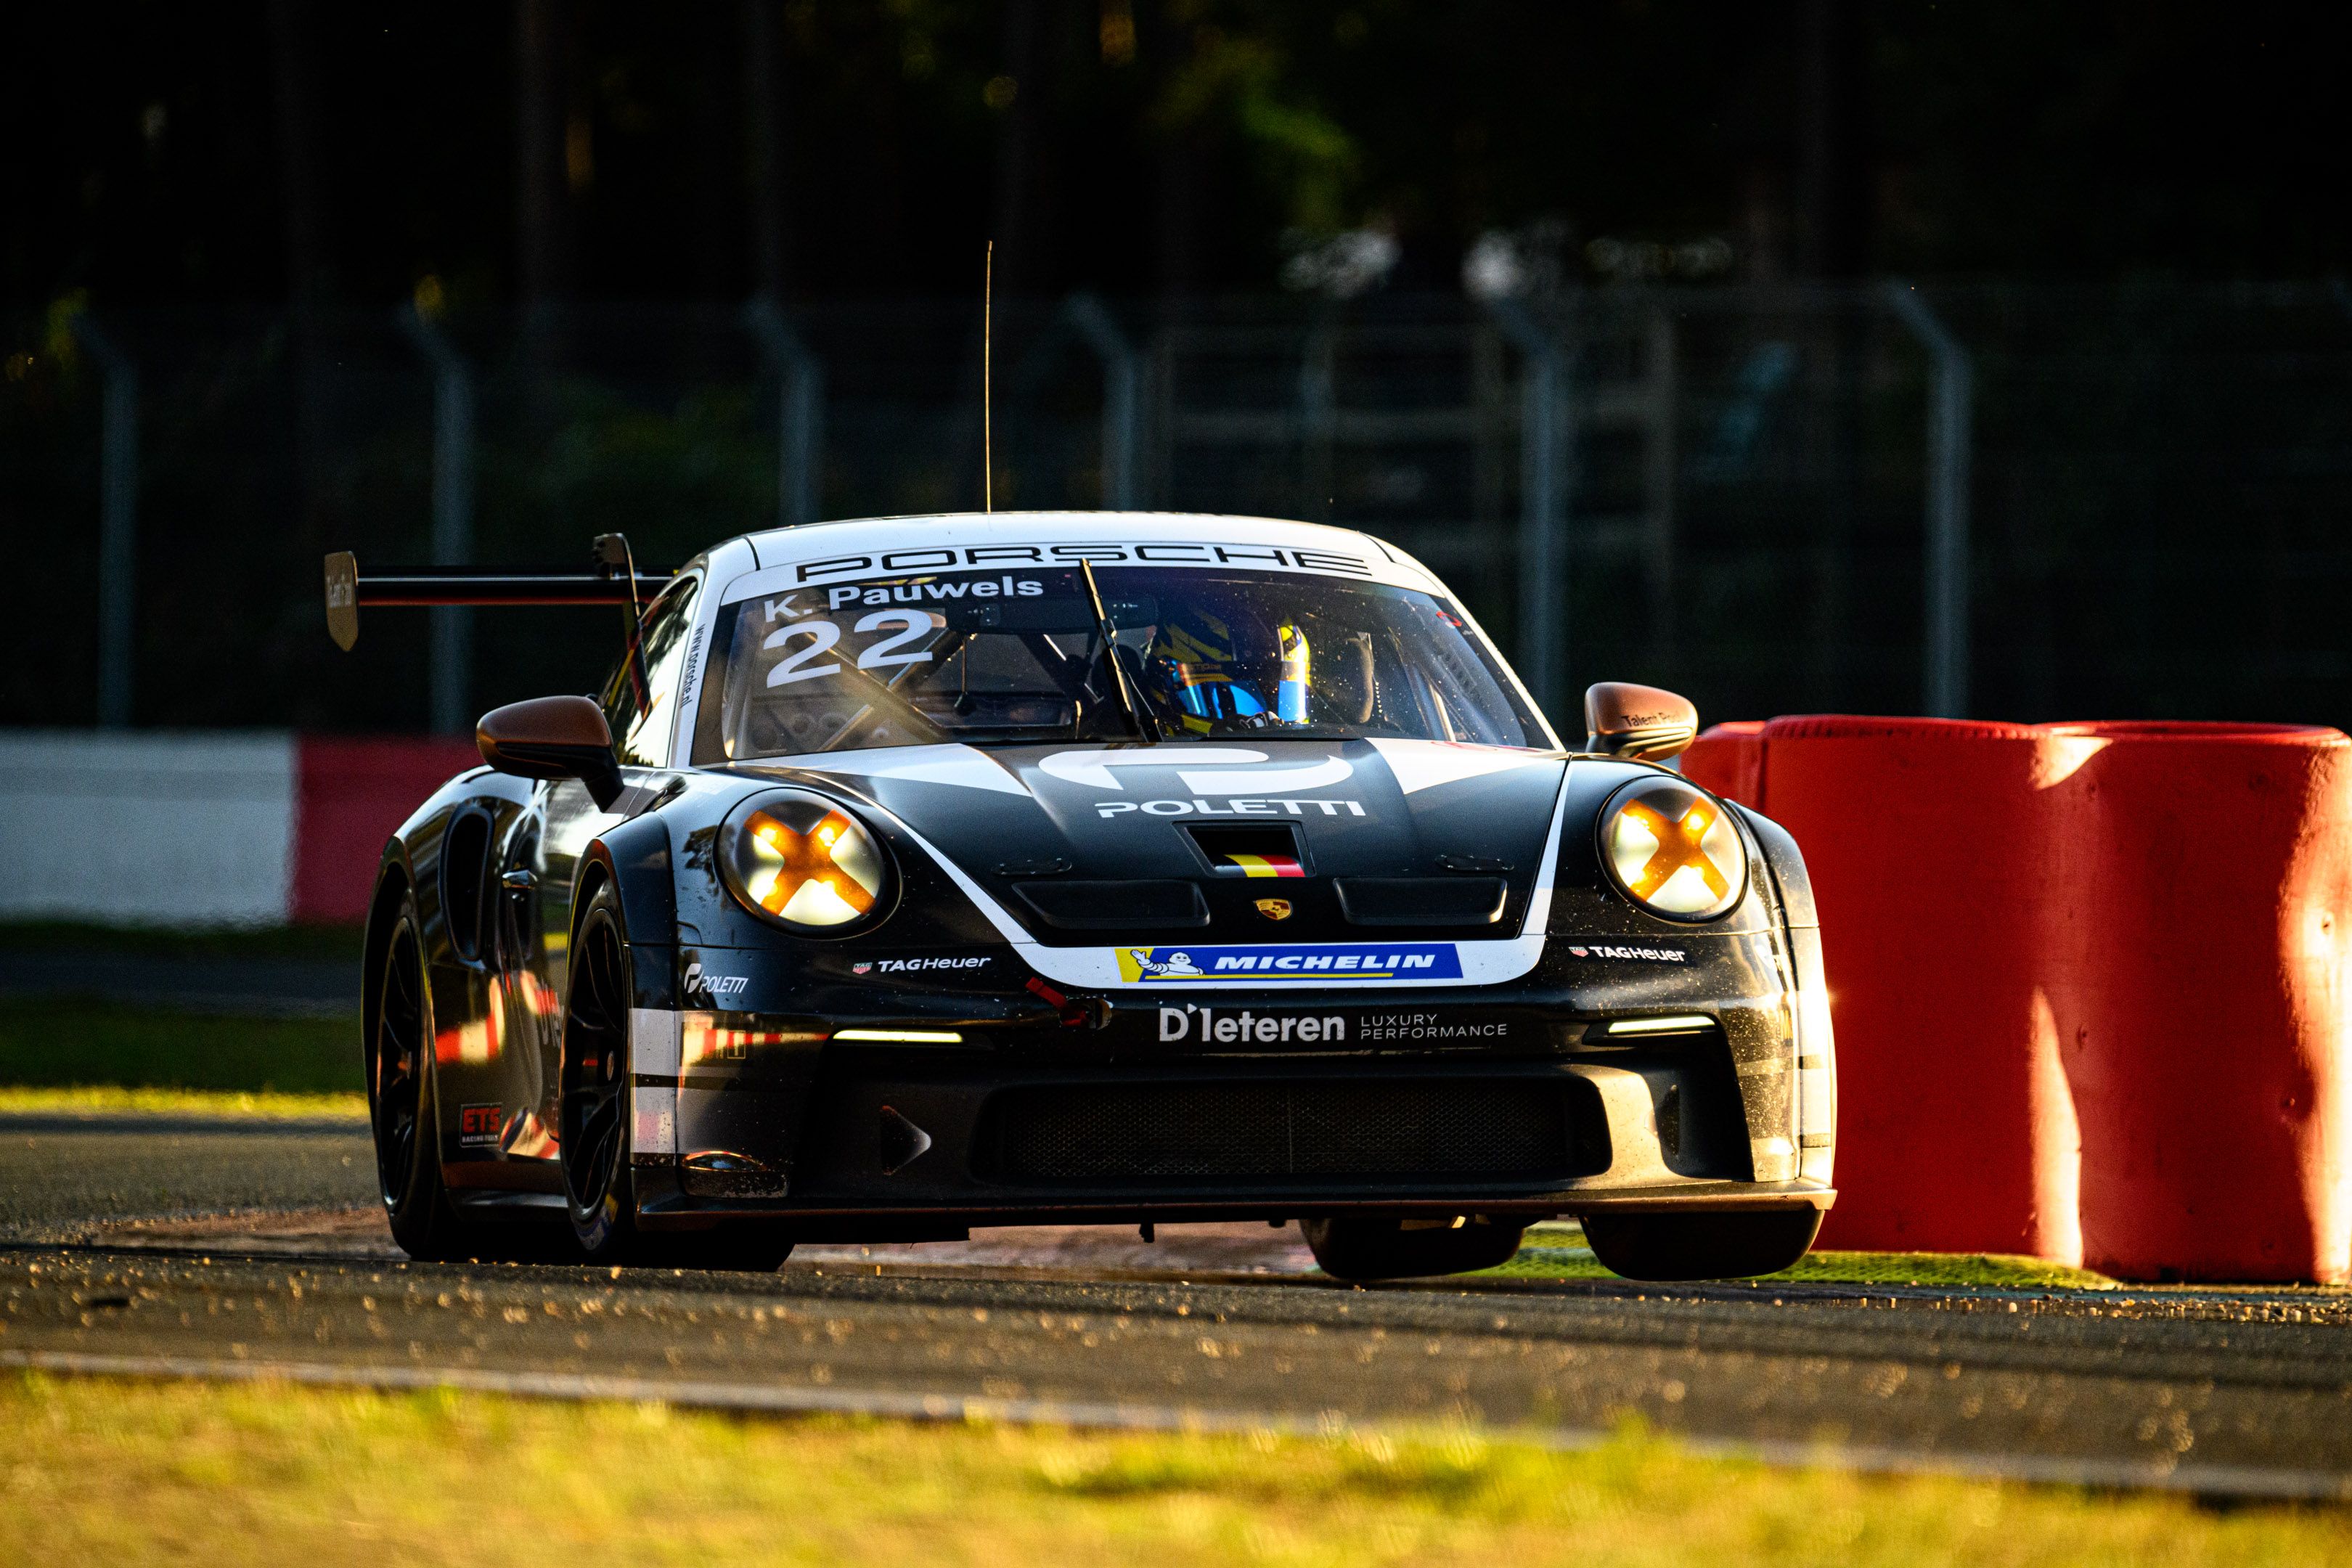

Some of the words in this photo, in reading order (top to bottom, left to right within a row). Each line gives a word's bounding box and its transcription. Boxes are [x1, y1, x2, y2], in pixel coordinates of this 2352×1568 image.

[796, 545, 1373, 582] PORSCHE
[764, 595, 814, 623] K.
[828, 576, 1044, 611] Pauwels
[763, 608, 934, 689] 22
[1094, 799, 1366, 819] POLETTI
[1214, 954, 1436, 971] MICHELIN
[699, 976, 749, 994] POLETTI
[1360, 1013, 1438, 1027] LUXURY
[1360, 1024, 1508, 1040] PERFORMANCE
[463, 1107, 501, 1133] ETS
